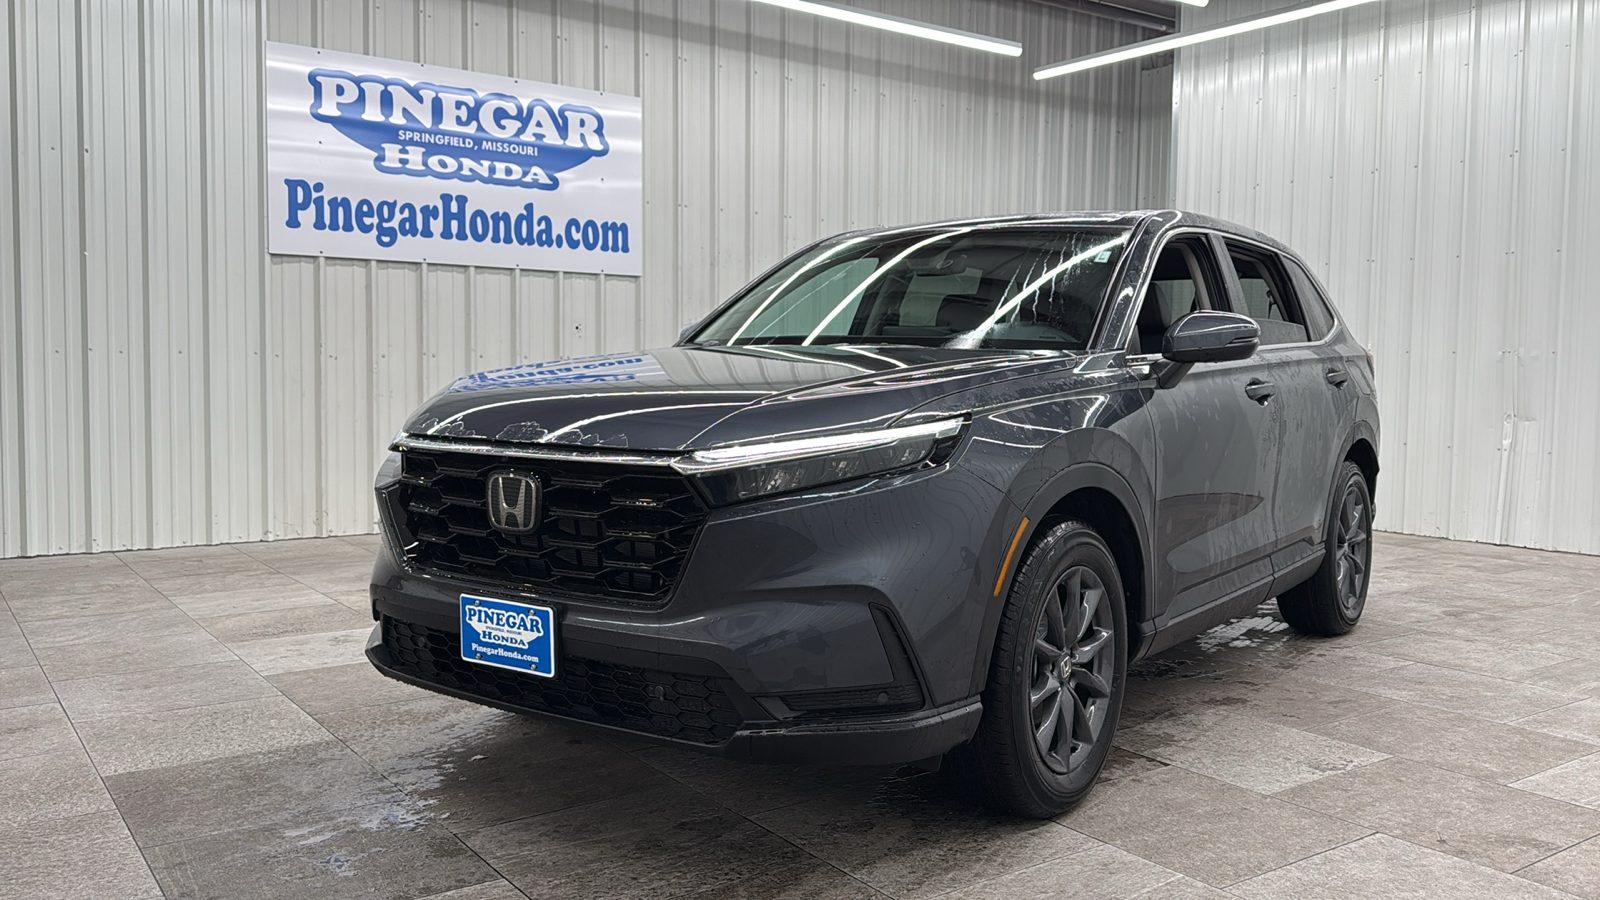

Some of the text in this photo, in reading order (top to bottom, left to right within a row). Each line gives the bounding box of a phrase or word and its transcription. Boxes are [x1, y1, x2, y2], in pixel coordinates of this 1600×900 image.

[316, 76, 604, 150] PINEGAR
[397, 129, 538, 157] SPRINGFIELD, MISSOURI
[380, 143, 554, 185] HONDA
[283, 178, 630, 254] PinegarHonda.com
[467, 607, 542, 634] PINEGAR
[471, 642, 539, 663] PinegarHonda.com
[481, 630, 527, 647] HONDA
